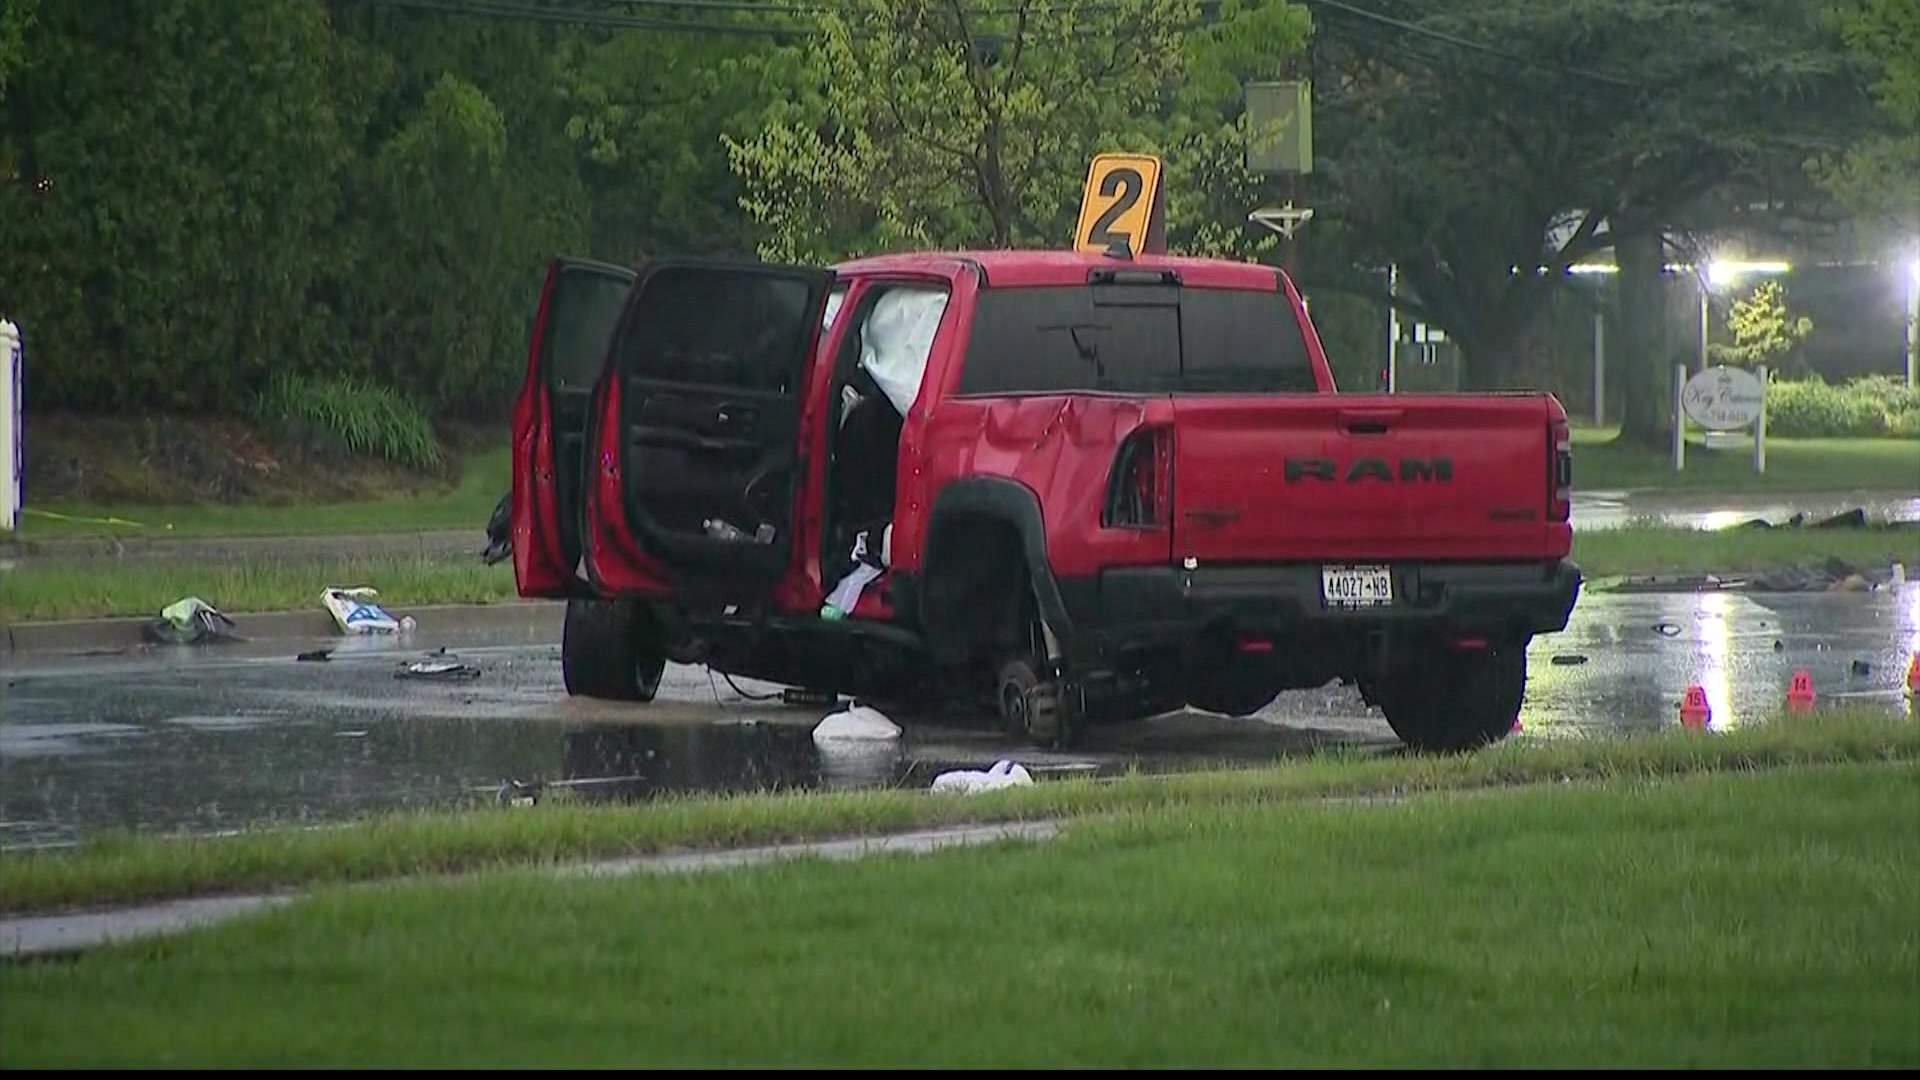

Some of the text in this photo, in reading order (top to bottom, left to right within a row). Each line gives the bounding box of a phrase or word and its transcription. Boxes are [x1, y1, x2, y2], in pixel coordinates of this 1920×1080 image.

[1087, 168, 1143, 246] 2
[1284, 457, 1454, 485] RAM
[1795, 678, 1807, 691] 14
[1688, 692, 1701, 706] 15
